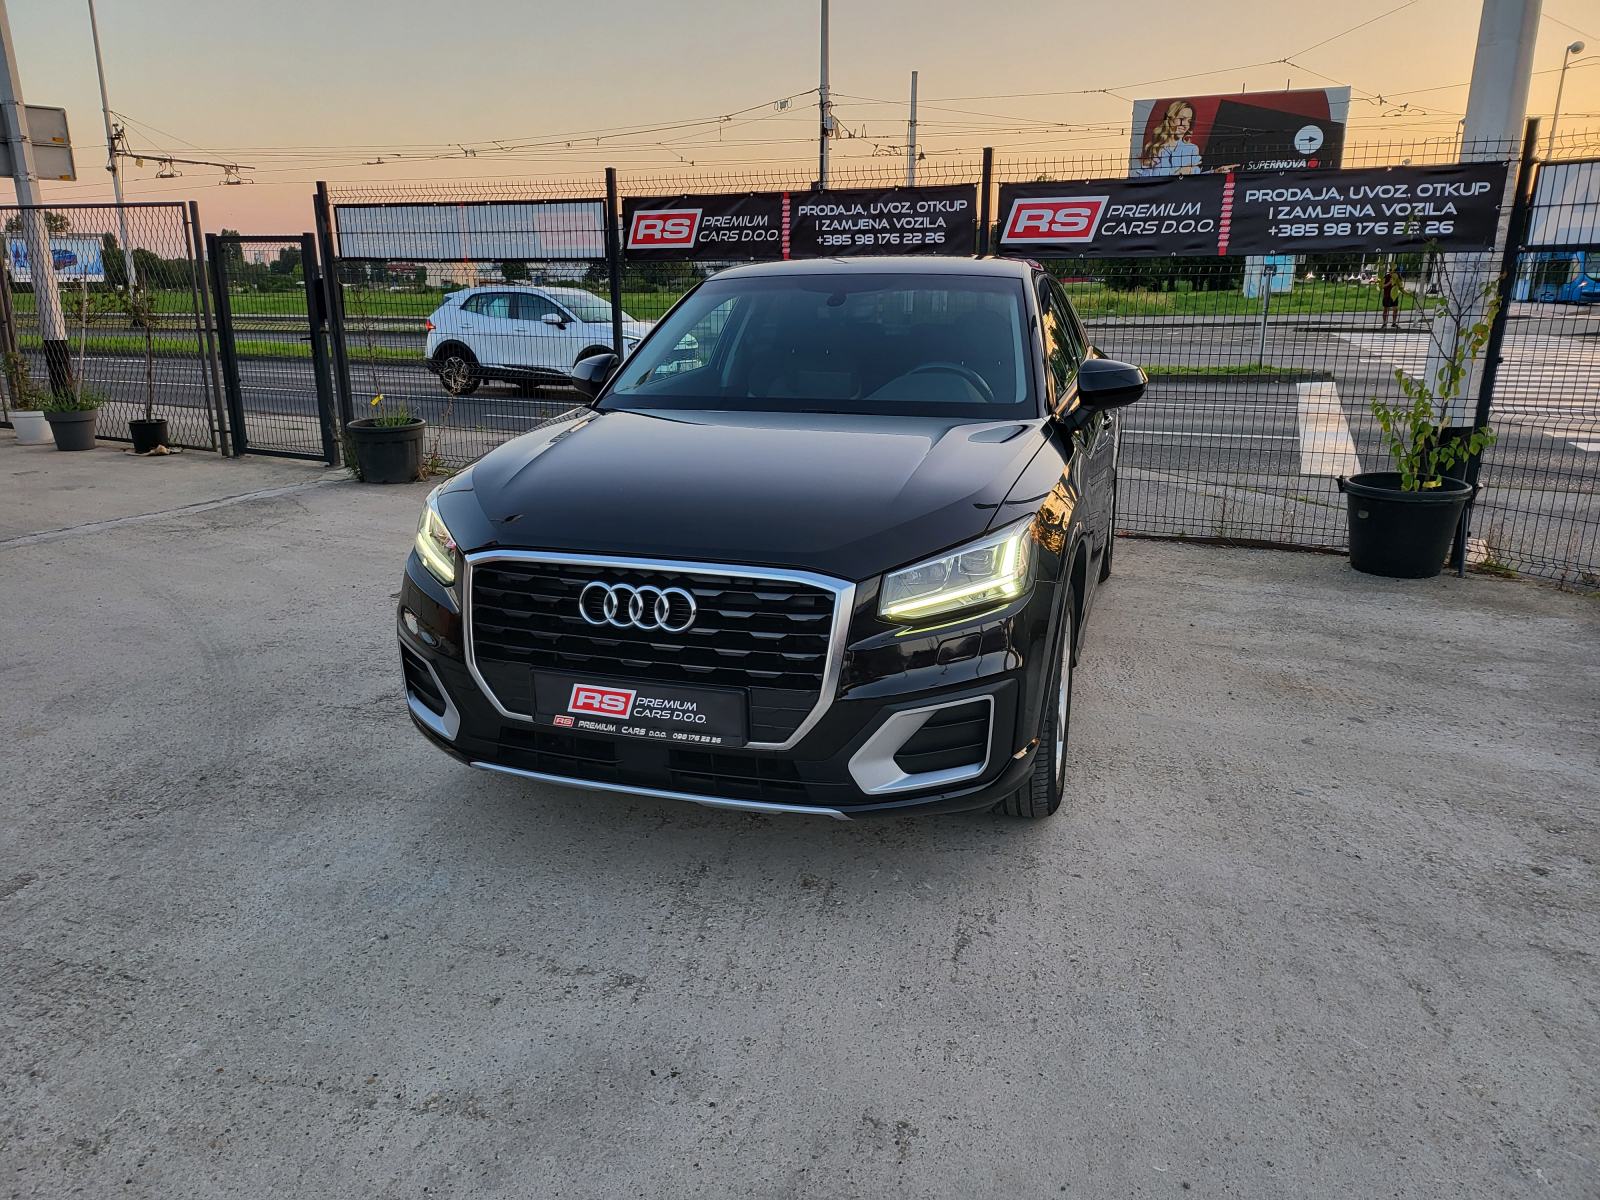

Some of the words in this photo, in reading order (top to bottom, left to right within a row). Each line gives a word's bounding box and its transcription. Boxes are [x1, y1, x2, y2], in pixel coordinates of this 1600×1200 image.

[1247, 159, 1306, 170] SUPERNOVA
[1246, 187, 1344, 202] PRODAJA,
[1350, 184, 1411, 200] UVOZ,
[1417, 182, 1491, 197] OTKUP
[798, 202, 867, 216] PRODAJA,
[870, 201, 914, 215] UVOZ,
[917, 200, 968, 213] OTKUP
[1107, 202, 1201, 218] PREMIUM
[1268, 207, 1273, 220] I
[1277, 204, 1375, 220] ZAMJENA
[1381, 201, 1458, 217] VOZILA
[702, 215, 769, 228] PREMIUM
[815, 219, 820, 231] I
[821, 217, 890, 231] ZAMJENA
[895, 216, 947, 229] VOZILA
[1014, 207, 1091, 233] RS
[1101, 221, 1158, 236] CARS
[1160, 219, 1215, 234] D.O.O.
[635, 219, 691, 240] RS
[699, 230, 738, 243] CARS
[738, 228, 779, 242] D.O.O.
[1268, 223, 1319, 237] +385
[1324, 223, 1351, 236] 98
[1356, 222, 1389, 236] 176
[1425, 220, 1454, 234] 26
[816, 233, 852, 246] +385
[855, 233, 875, 245] 98
[878, 232, 900, 245] 176
[903, 232, 922, 244] 22
[925, 231, 945, 244] 26
[576, 690, 626, 711] RS
[636, 697, 697, 712] PREMIUM
[633, 708, 671, 719] CARS
[673, 711, 707, 723] D.O.O.
[578, 721, 616, 732] PREMIUM
[621, 726, 646, 736] CARS
